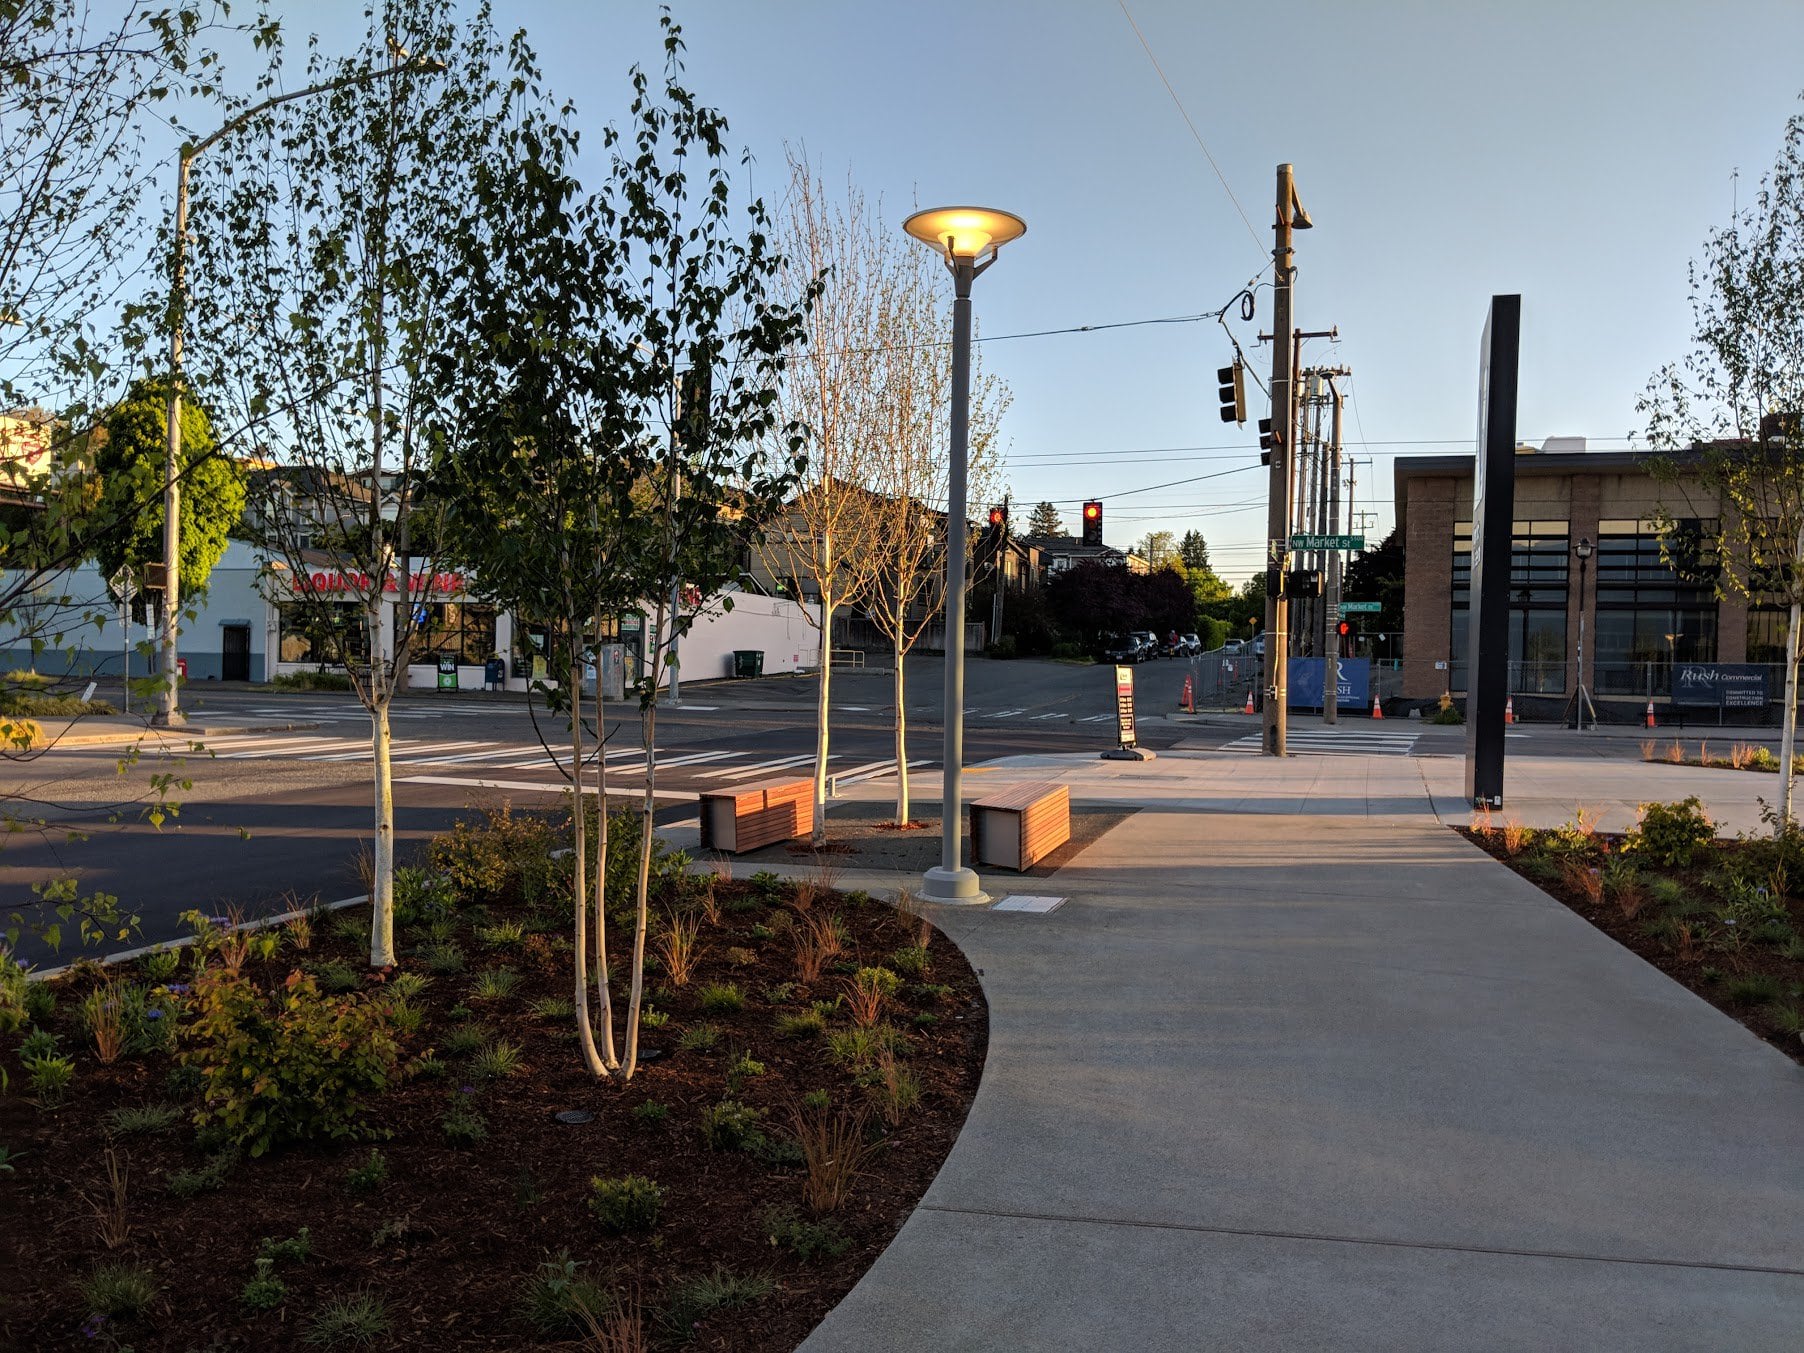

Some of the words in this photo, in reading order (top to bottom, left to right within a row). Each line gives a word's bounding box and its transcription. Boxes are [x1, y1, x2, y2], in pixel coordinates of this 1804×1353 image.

[1292, 539, 1304, 548] NW
[1306, 536, 1339, 549] Market
[1342, 539, 1350, 548] St
[407, 572, 464, 592] WNE
[440, 663, 455, 671] WIN
[1680, 669, 1719, 680] Rush
[1721, 673, 1763, 681] Commercial
